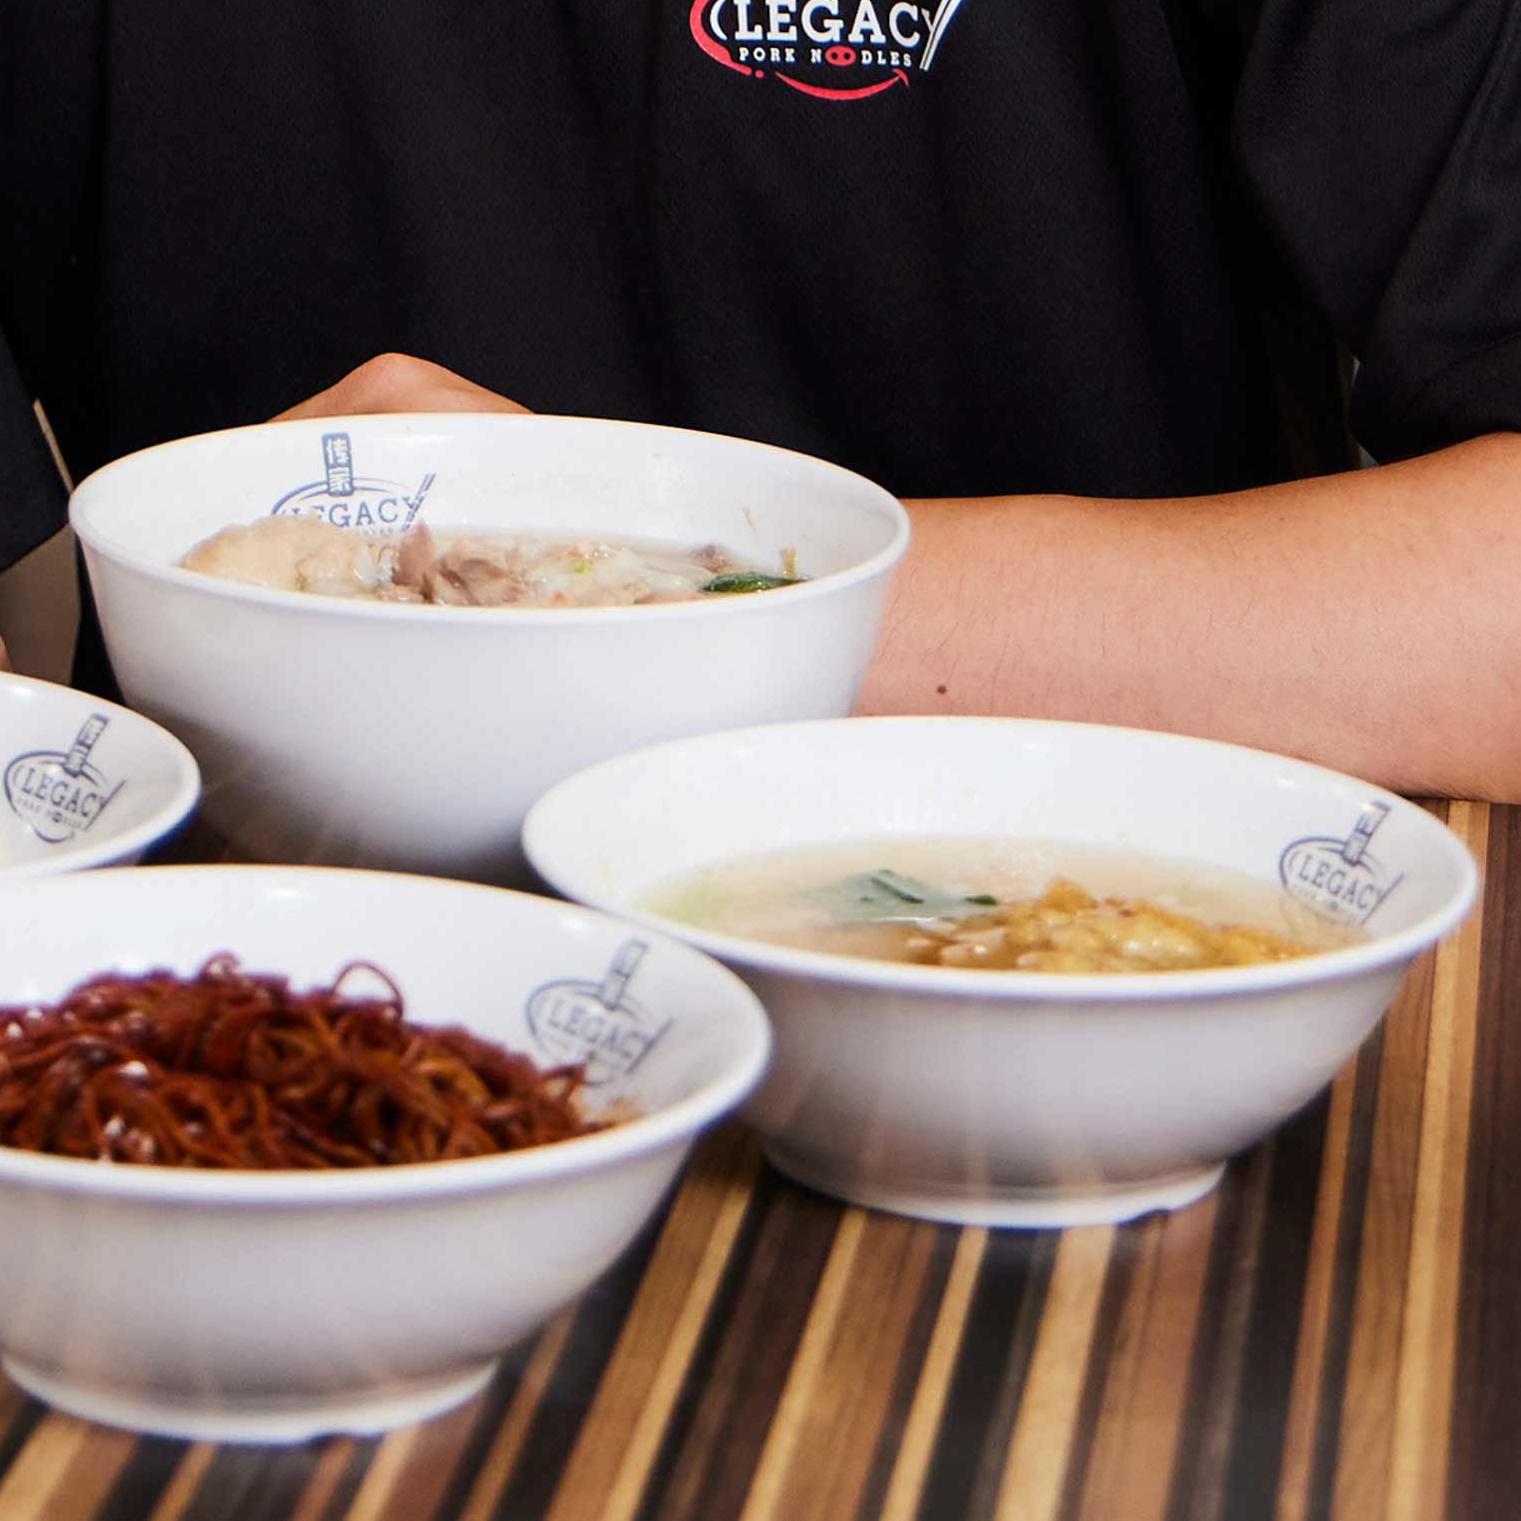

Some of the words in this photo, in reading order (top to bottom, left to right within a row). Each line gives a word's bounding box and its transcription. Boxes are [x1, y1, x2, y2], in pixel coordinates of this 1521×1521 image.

[739, 47, 796, 63] PORK
[810, 44, 913, 68] NOODLES
[292, 486, 426, 531] GACY
